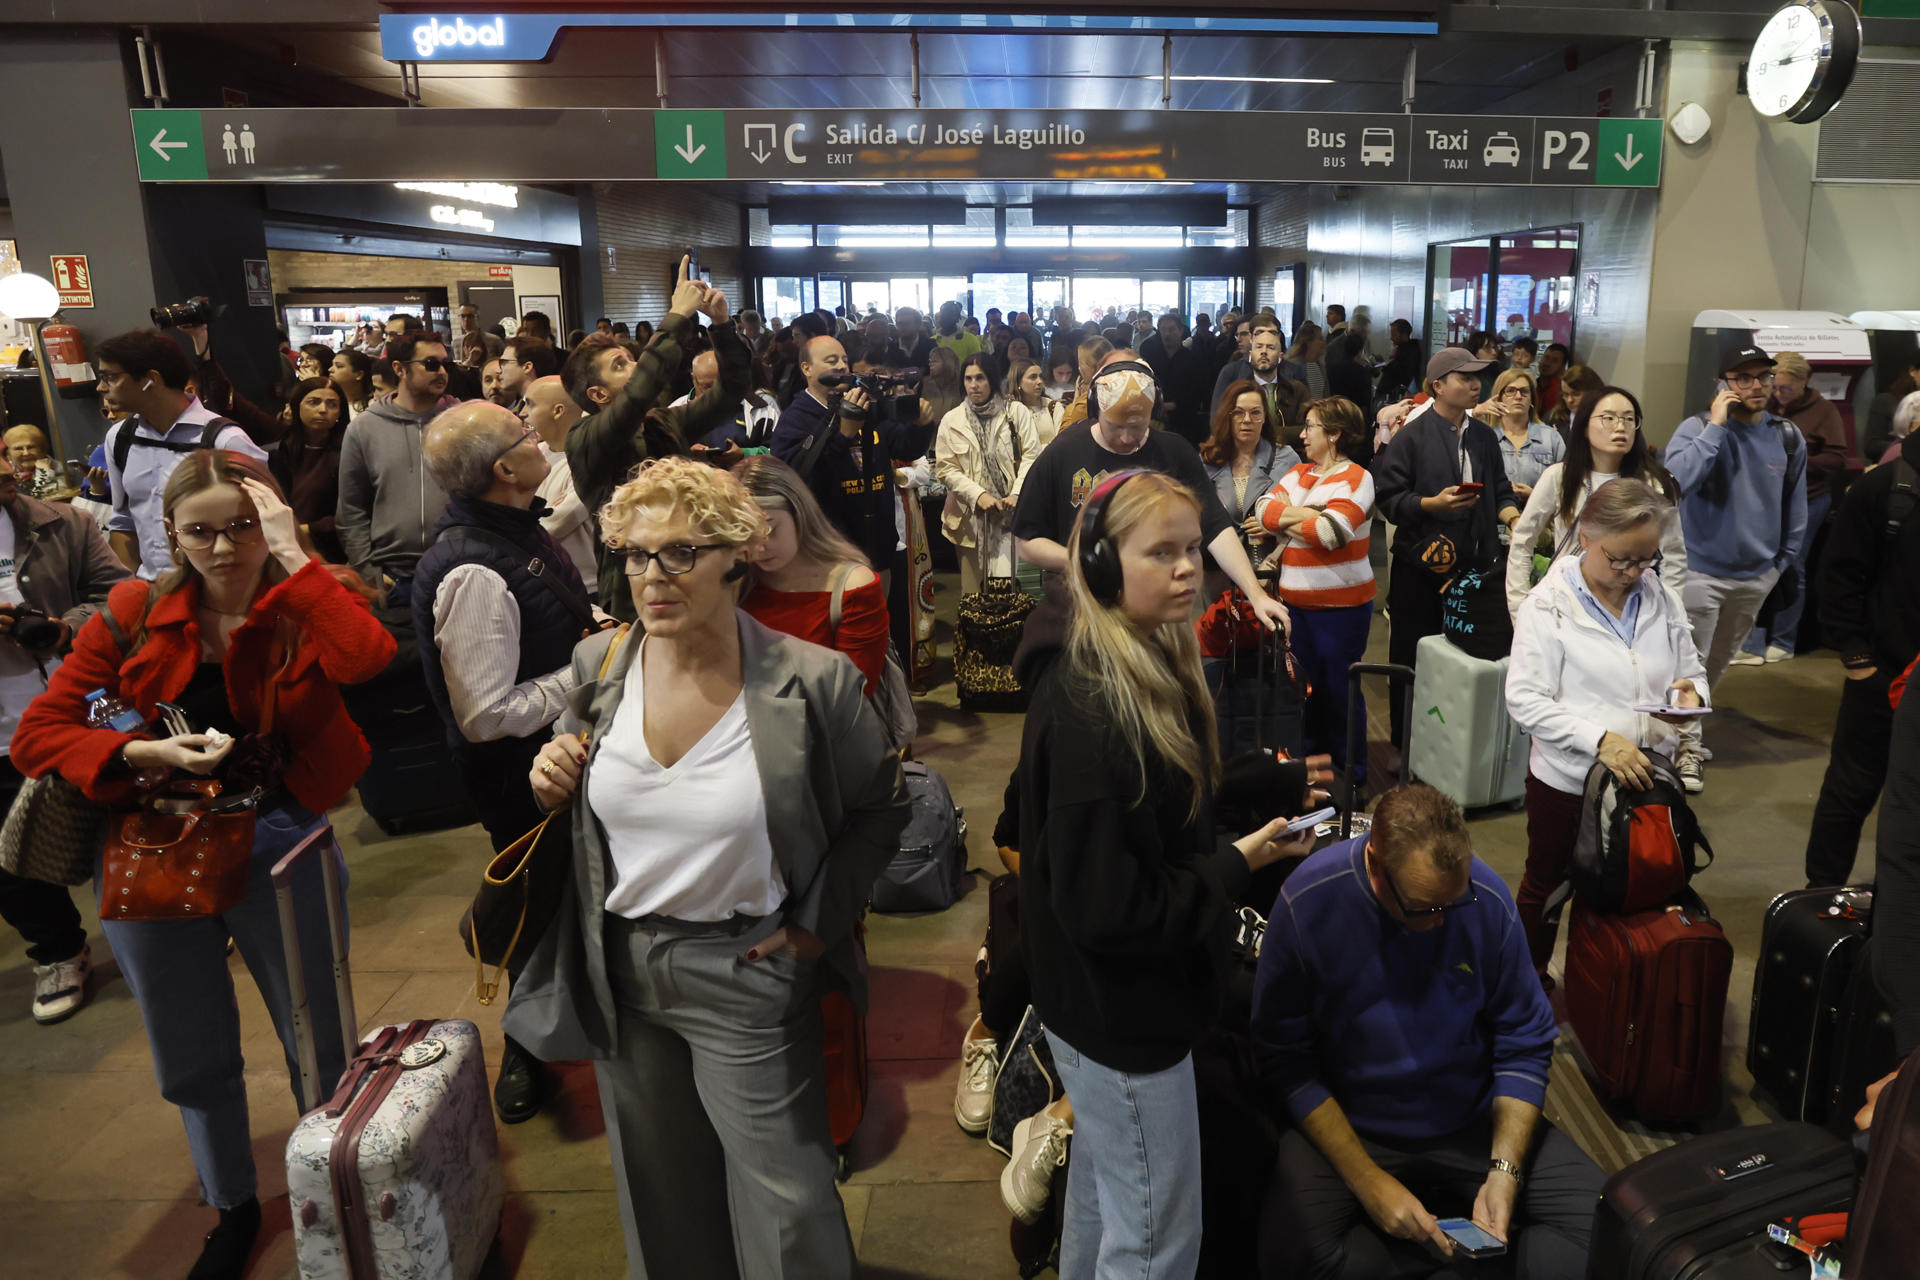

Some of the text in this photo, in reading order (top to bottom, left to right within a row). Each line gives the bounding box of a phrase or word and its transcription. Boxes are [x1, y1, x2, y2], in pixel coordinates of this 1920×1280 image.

[1786, 14, 1801, 30] 12
[412, 16, 505, 57] global
[1778, 94, 1788, 108] 6
[783, 122, 807, 164] C
[826, 122, 1086, 150] Salida C/ José Laguillo
[1306, 127, 1347, 149] Bus
[1425, 128, 1469, 151] Taxi
[827, 153, 854, 165] EXIT
[1542, 130, 1591, 171] P2
[1323, 157, 1346, 168] BUS
[1443, 158, 1468, 170] TAXI
[60, 295, 91, 304] EXTINTOR
[1446, 597, 1468, 613] OVE
[1444, 614, 1475, 634] ATAR
